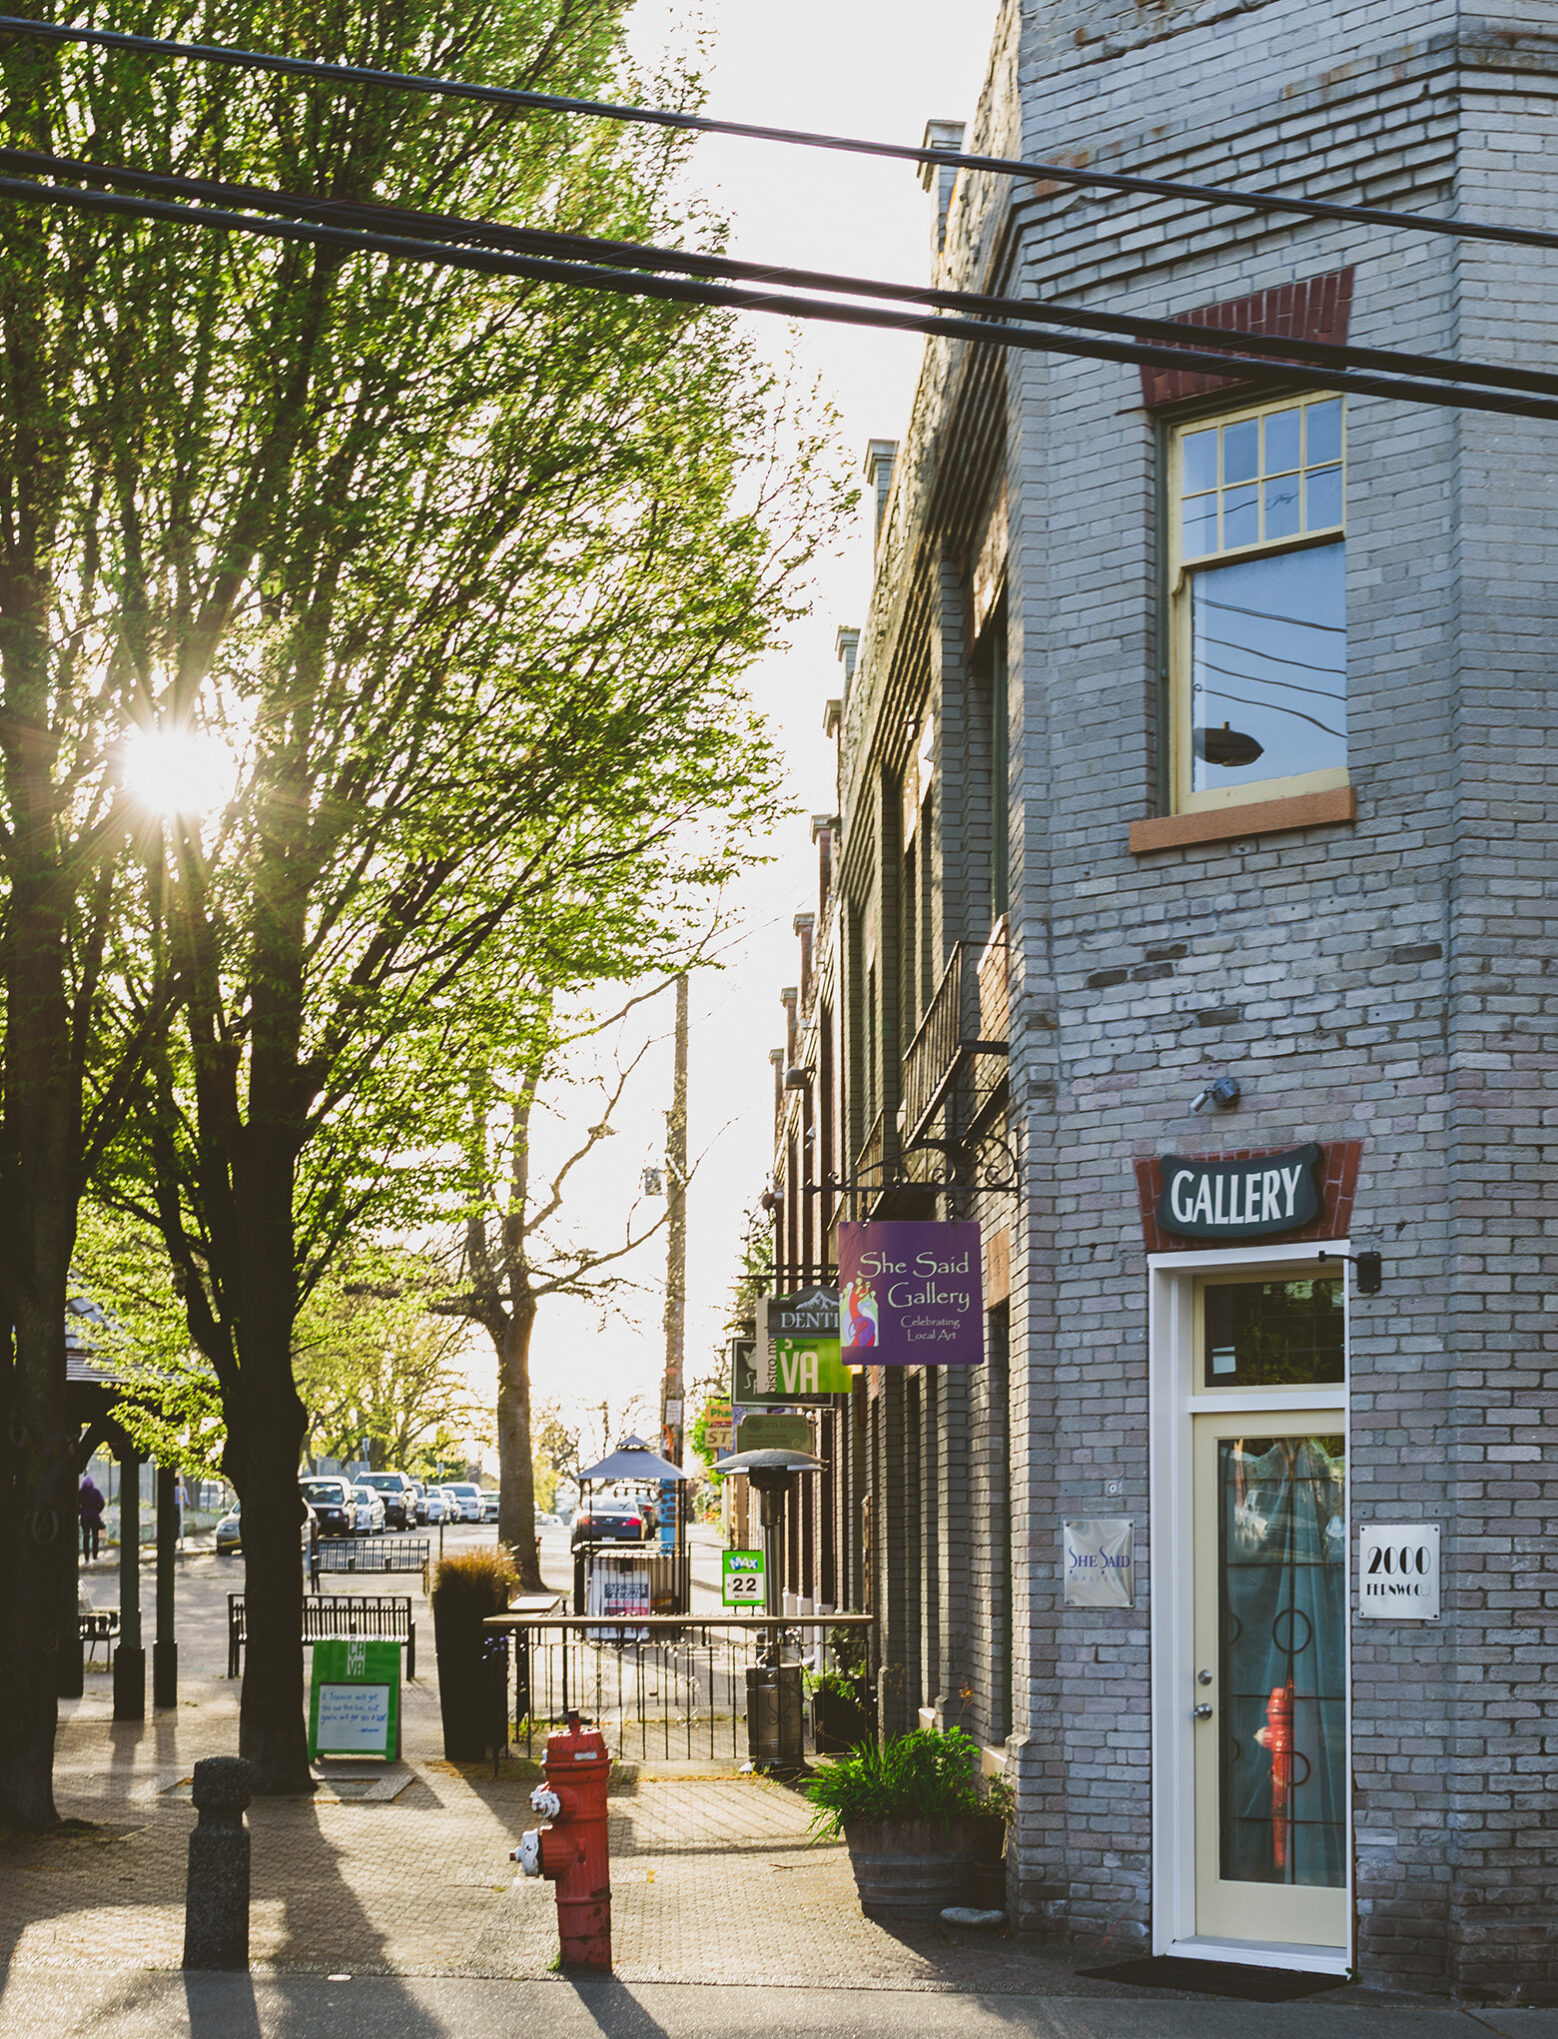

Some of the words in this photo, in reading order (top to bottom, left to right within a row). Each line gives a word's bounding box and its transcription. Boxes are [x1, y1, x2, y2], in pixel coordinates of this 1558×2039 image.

[1171, 1164, 1303, 1225] GALLERY
[857, 1251, 907, 1278] She
[913, 1251, 969, 1278] Said
[888, 1281, 970, 1312] Gallery
[901, 1315, 961, 1329] Celebrating
[907, 1329, 937, 1341] Local
[938, 1329, 957, 1341] Art
[779, 1351, 820, 1394] VA
[1367, 1546, 1432, 1575] 2000
[347, 1660, 364, 1676] VA
